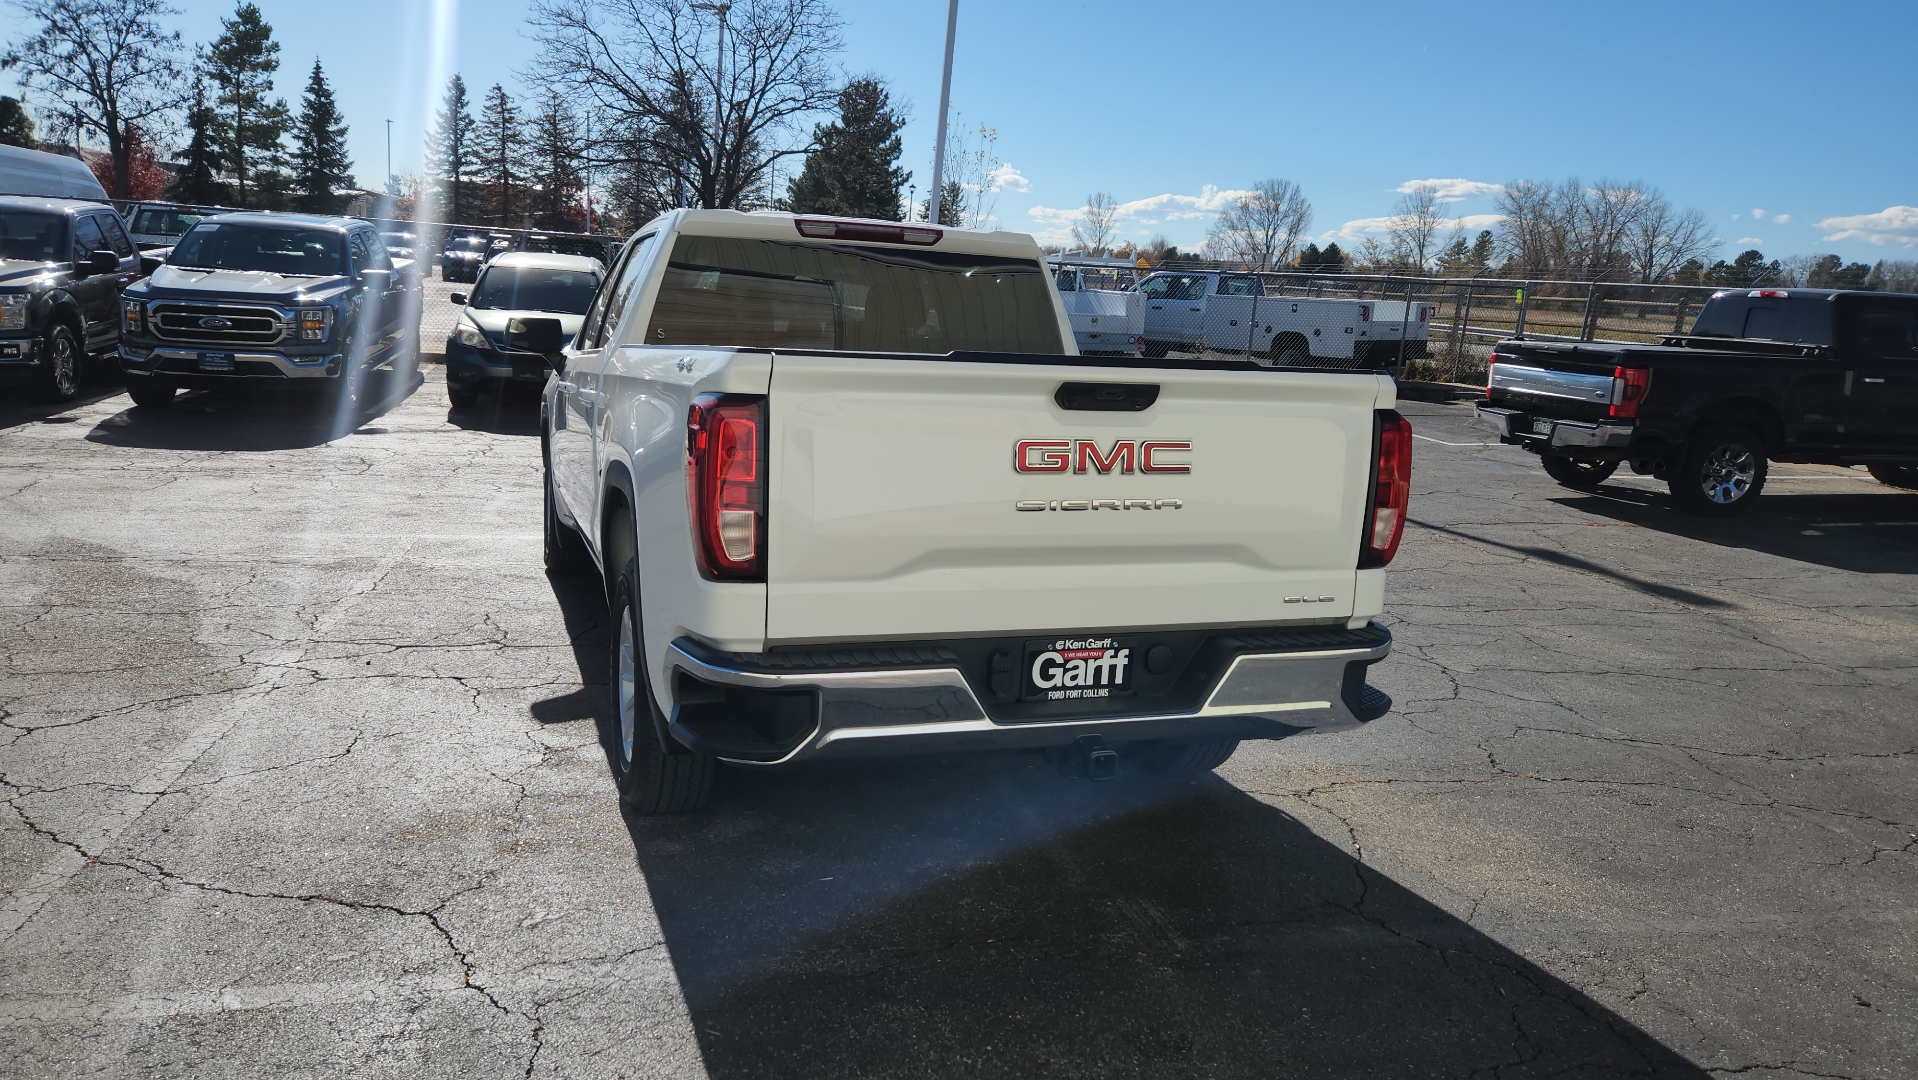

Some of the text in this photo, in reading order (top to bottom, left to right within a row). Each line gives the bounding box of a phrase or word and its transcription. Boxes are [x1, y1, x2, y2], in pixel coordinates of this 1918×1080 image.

[1013, 438, 1192, 475] GMC
[1015, 498, 1183, 512] SIERRA
[1065, 638, 1112, 650] Ken Garff
[1032, 648, 1130, 689] Garff
[1048, 688, 1109, 700] FORD FORT COLLINS
